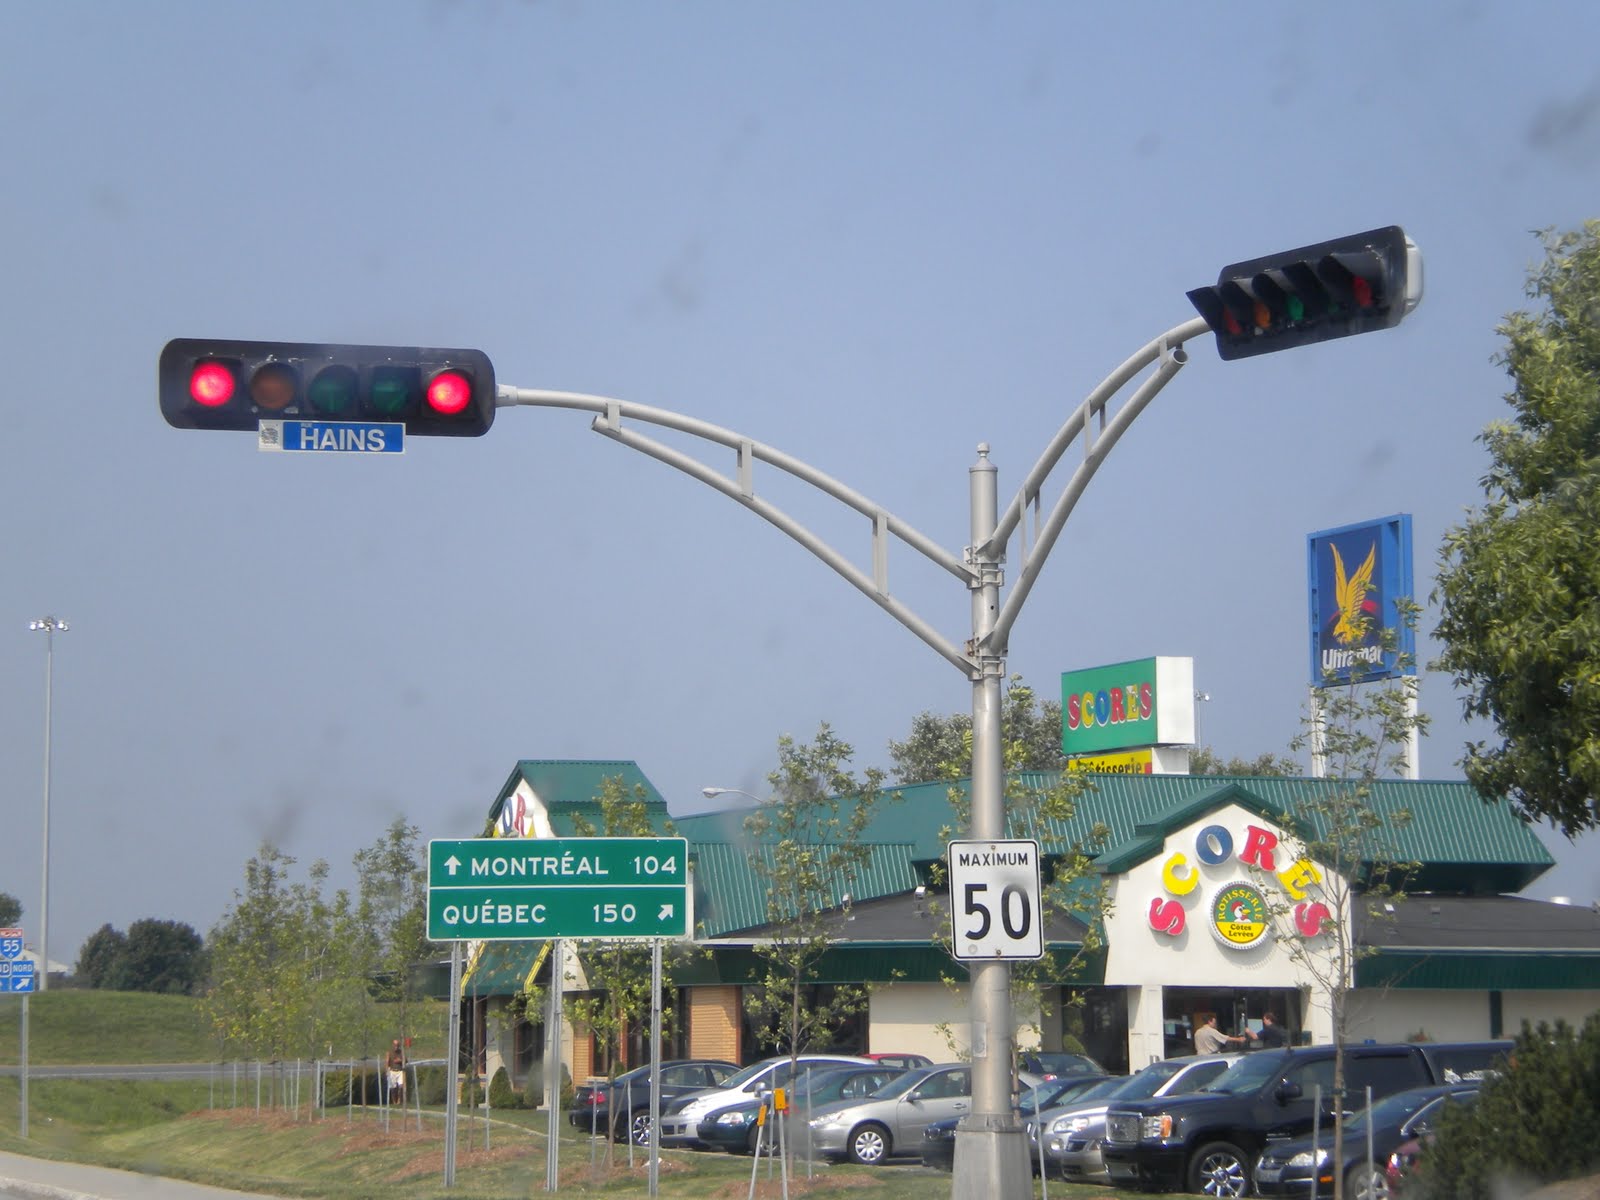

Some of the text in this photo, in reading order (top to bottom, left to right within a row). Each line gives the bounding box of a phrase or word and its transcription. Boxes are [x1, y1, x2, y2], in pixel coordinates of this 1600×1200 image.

[300, 428, 386, 451] HAINS
[1068, 682, 1152, 731] SCORES
[1072, 757, 1143, 773] tisserie
[471, 851, 677, 876] MONTRÉAL 104
[959, 853, 1028, 866] MAXIMUM
[1149, 825, 1331, 936] SCORES
[443, 899, 637, 925] QUÉBEC 150
[964, 884, 1031, 940] 50
[3, 939, 20, 952] 55
[12, 964, 33, 972] NORD
